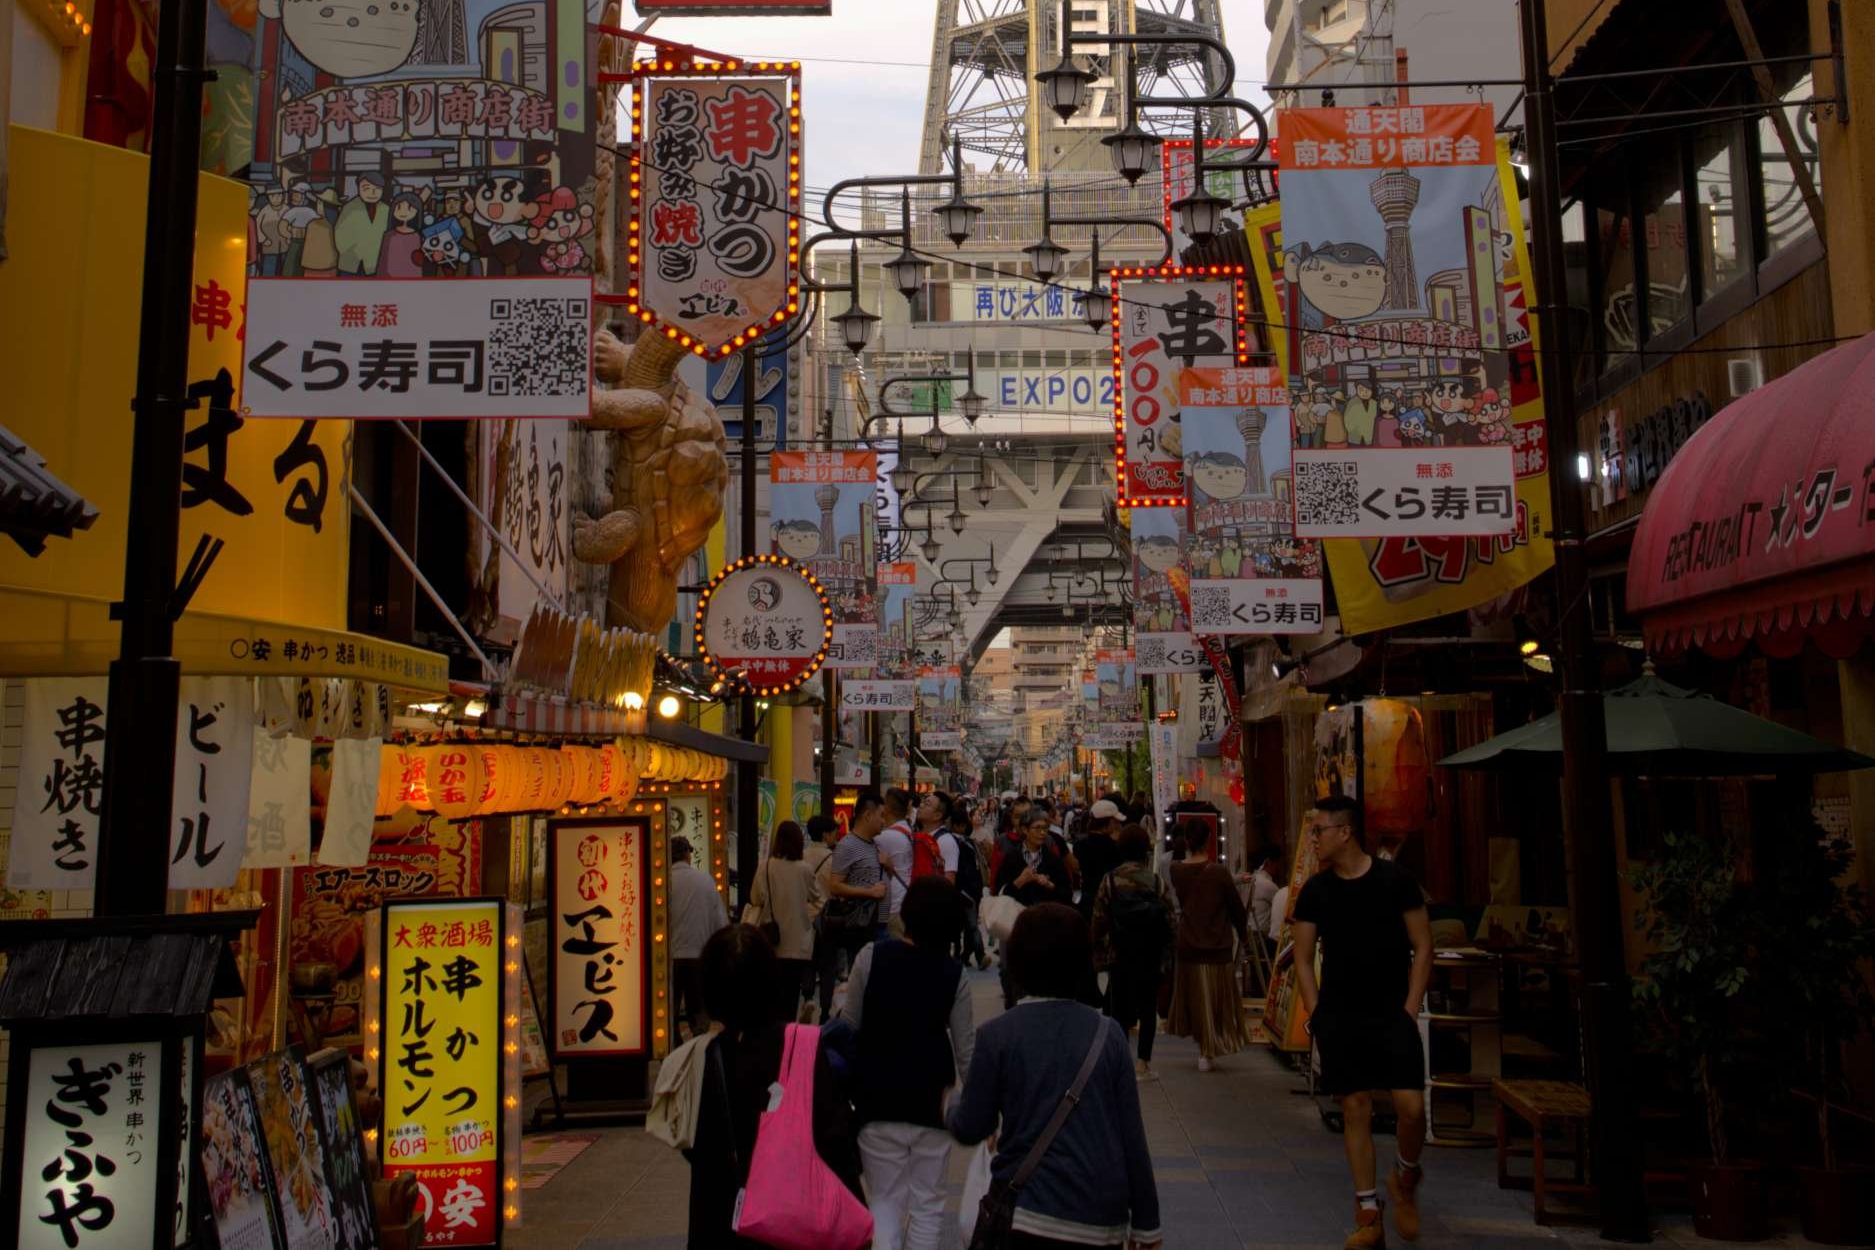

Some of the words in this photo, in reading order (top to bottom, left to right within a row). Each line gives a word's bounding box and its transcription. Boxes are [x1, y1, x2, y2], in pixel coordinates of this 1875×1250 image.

[283, 87, 555, 139] 南本通り商店街
[1345, 108, 1424, 134] 通天閣
[1293, 135, 1480, 166] 南本通り商店会
[650, 88, 704, 281] お好み焼き
[704, 86, 782, 277] 串かつ
[192, 280, 243, 342] 串
[341, 303, 399, 328] 無添
[976, 286, 1110, 318] 再び大阪
[248, 340, 484, 393] くら寿司
[1221, 368, 1271, 386] 通天閣
[1189, 387, 1288, 405] 南本通り商店
[1415, 462, 1453, 478] 無添
[1361, 486, 1513, 520] くら寿司
[1232, 603, 1321, 625] くら寿司
[284, 639, 328, 662] 串かつ
[1166, 650, 1212, 667] くら寿
[843, 693, 893, 706] くら寿司
[41, 696, 105, 870] 串焼き
[172, 701, 225, 868] ビール
[394, 919, 493, 949] 大衆酒場
[399, 956, 437, 1116] ホルモン
[441, 955, 482, 1116] 串かつ
[126, 1052, 146, 1107] 新世界
[39, 1058, 122, 1248] ぎふや
[126, 1111, 144, 1165] 串かつ
[452, 1130, 494, 1154] 100円
